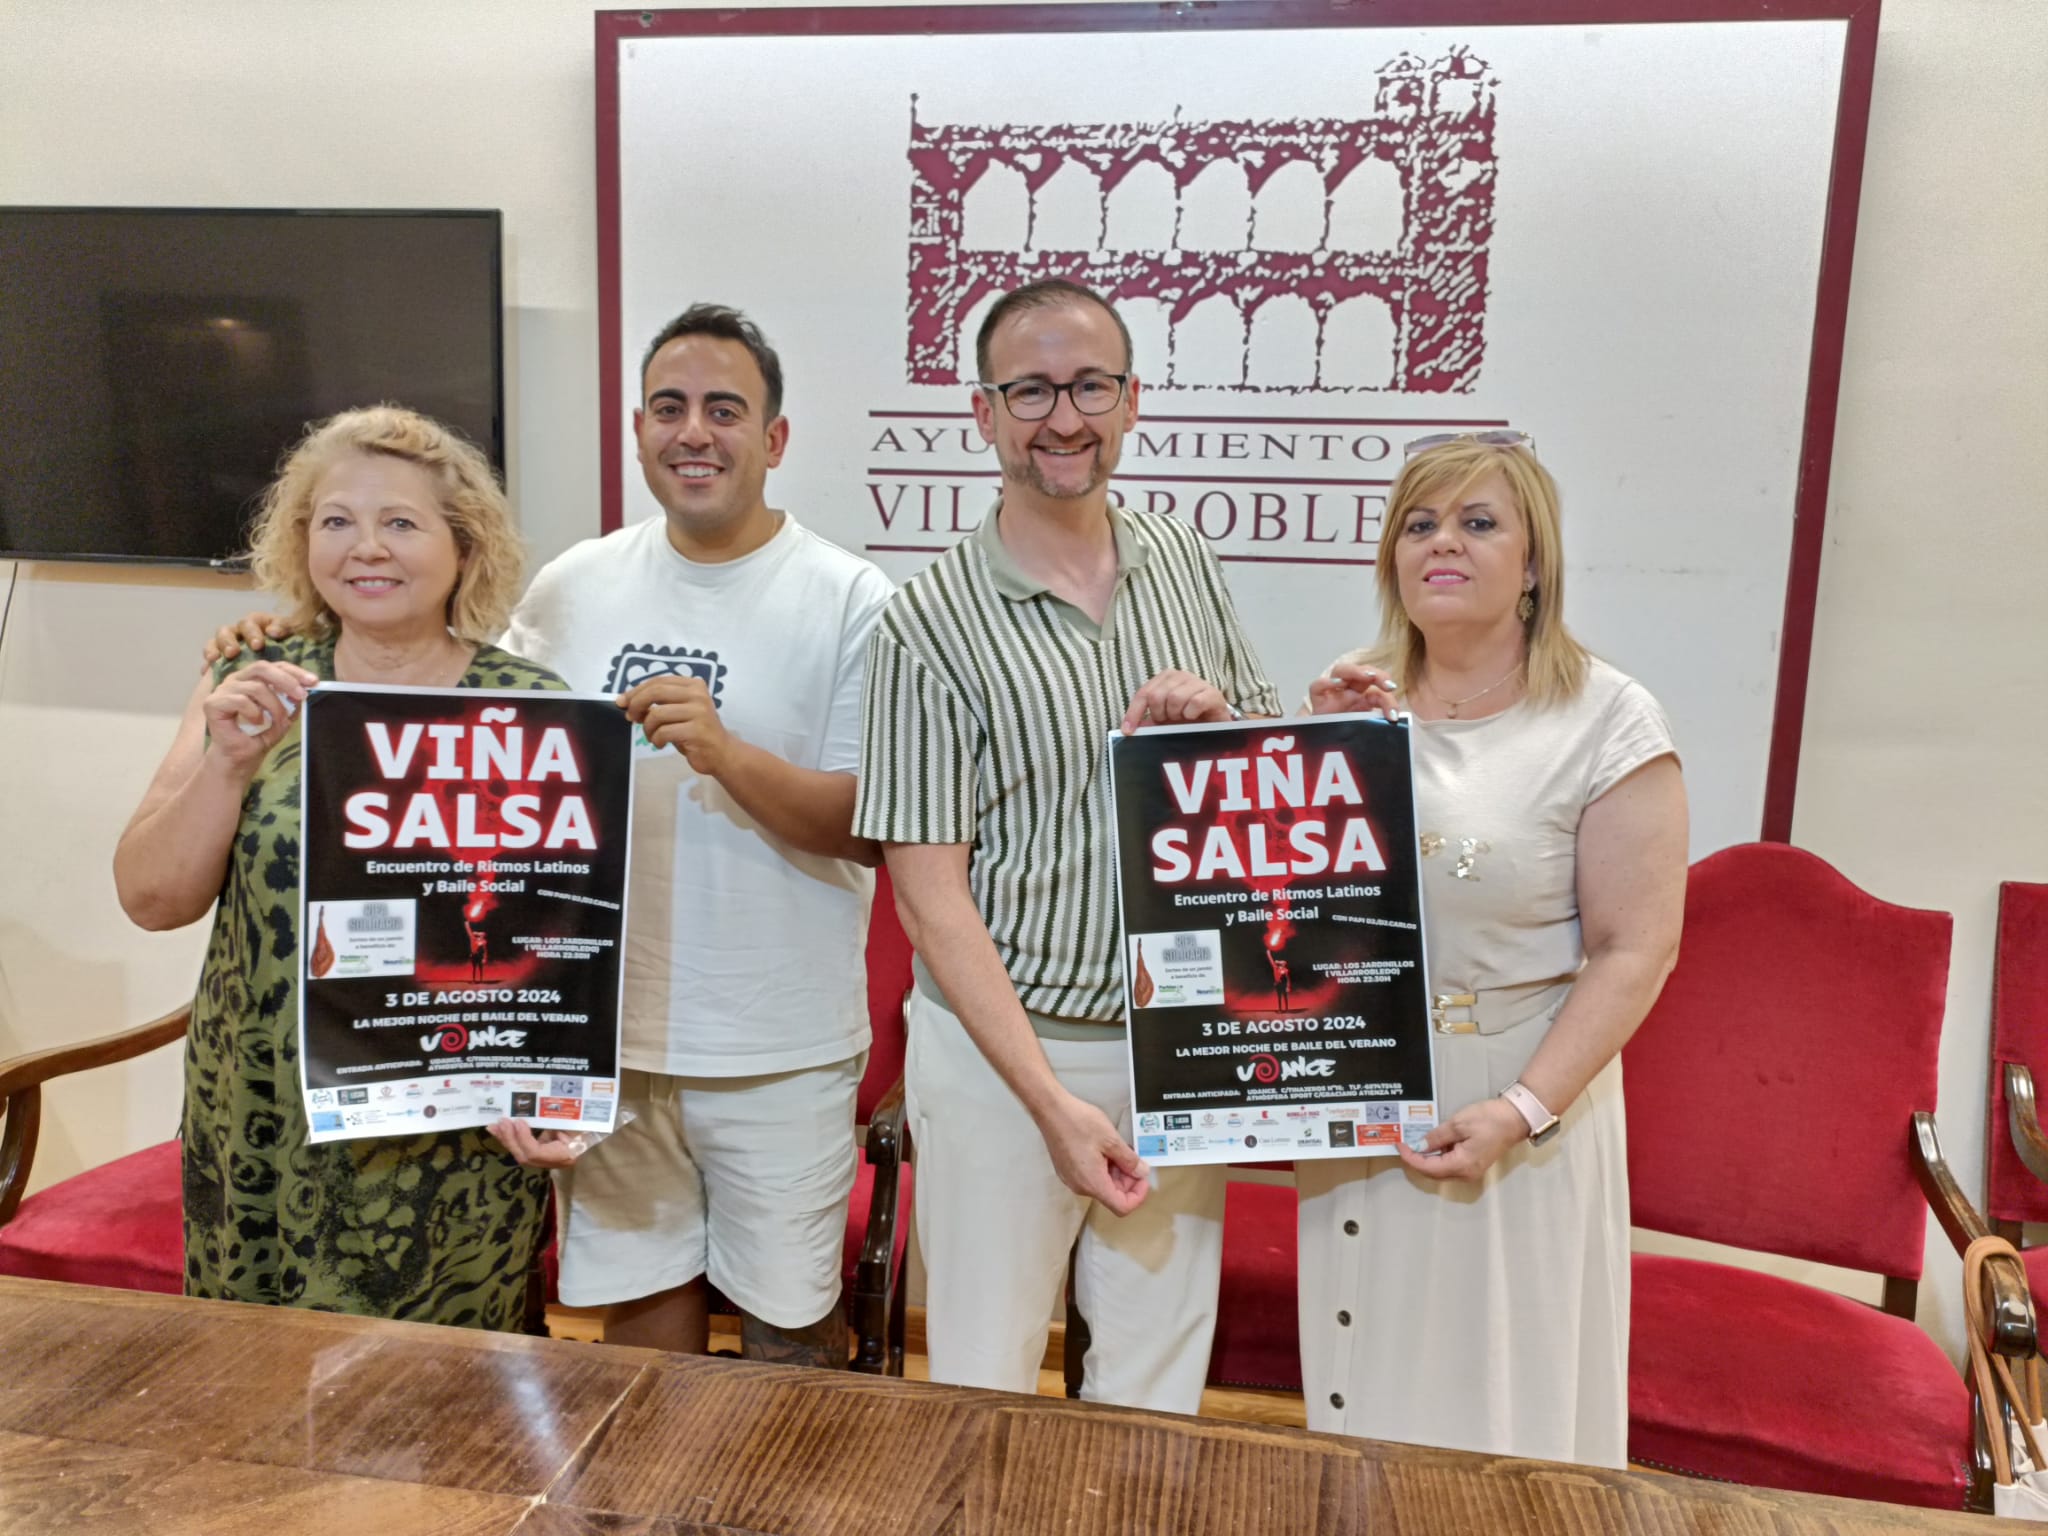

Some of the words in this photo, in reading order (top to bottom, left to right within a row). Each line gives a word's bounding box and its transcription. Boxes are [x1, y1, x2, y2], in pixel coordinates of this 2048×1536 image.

[365, 707, 581, 783] VIÑA
[1163, 736, 1363, 814] VIÑA
[344, 791, 598, 850] SALSA
[1152, 817, 1386, 883] SALSA
[366, 860, 450, 874] Encuentro
[453, 861, 473, 873] de
[476, 860, 531, 873] Ritmos
[534, 860, 590, 874] Latinos
[422, 882, 434, 896] y
[436, 879, 476, 893] Baile
[479, 879, 525, 893] Social
[1174, 891, 1248, 906] Encuentro
[1251, 890, 1269, 902] de
[1272, 887, 1324, 901] Ritmos
[1326, 885, 1381, 898] Latinos
[1225, 912, 1235, 926] y
[1237, 909, 1274, 922] Baile
[1276, 906, 1319, 920] Social
[1361, 960, 1415, 969] JARDINILLOS
[385, 993, 398, 1007] 3
[402, 992, 430, 1007] DE
[434, 989, 513, 1005] AGOSTO
[517, 989, 561, 1004] 2024
[353, 1019, 370, 1029] LA
[372, 1015, 416, 1027] MEJOR
[418, 1013, 461, 1024] NOCHE
[462, 1013, 479, 1022] DE
[481, 1012, 515, 1021] BAILE
[517, 1012, 539, 1021] DEL
[541, 1013, 588, 1023] VERANO
[1202, 1023, 1213, 1036] 3
[1217, 1022, 1241, 1035] DE
[1245, 1018, 1319, 1034] AGOSTO
[1323, 1016, 1366, 1030] 2024
[1176, 1048, 1190, 1057] LA
[1192, 1046, 1230, 1056] MEJOR
[1232, 1043, 1271, 1054] NOCHE
[1273, 1042, 1289, 1051] DE
[1291, 1041, 1323, 1051] BAILE
[1325, 1040, 1346, 1049] DEL
[1348, 1038, 1396, 1048] VERANO
[1163, 1092, 1196, 1100] ENTRADA
